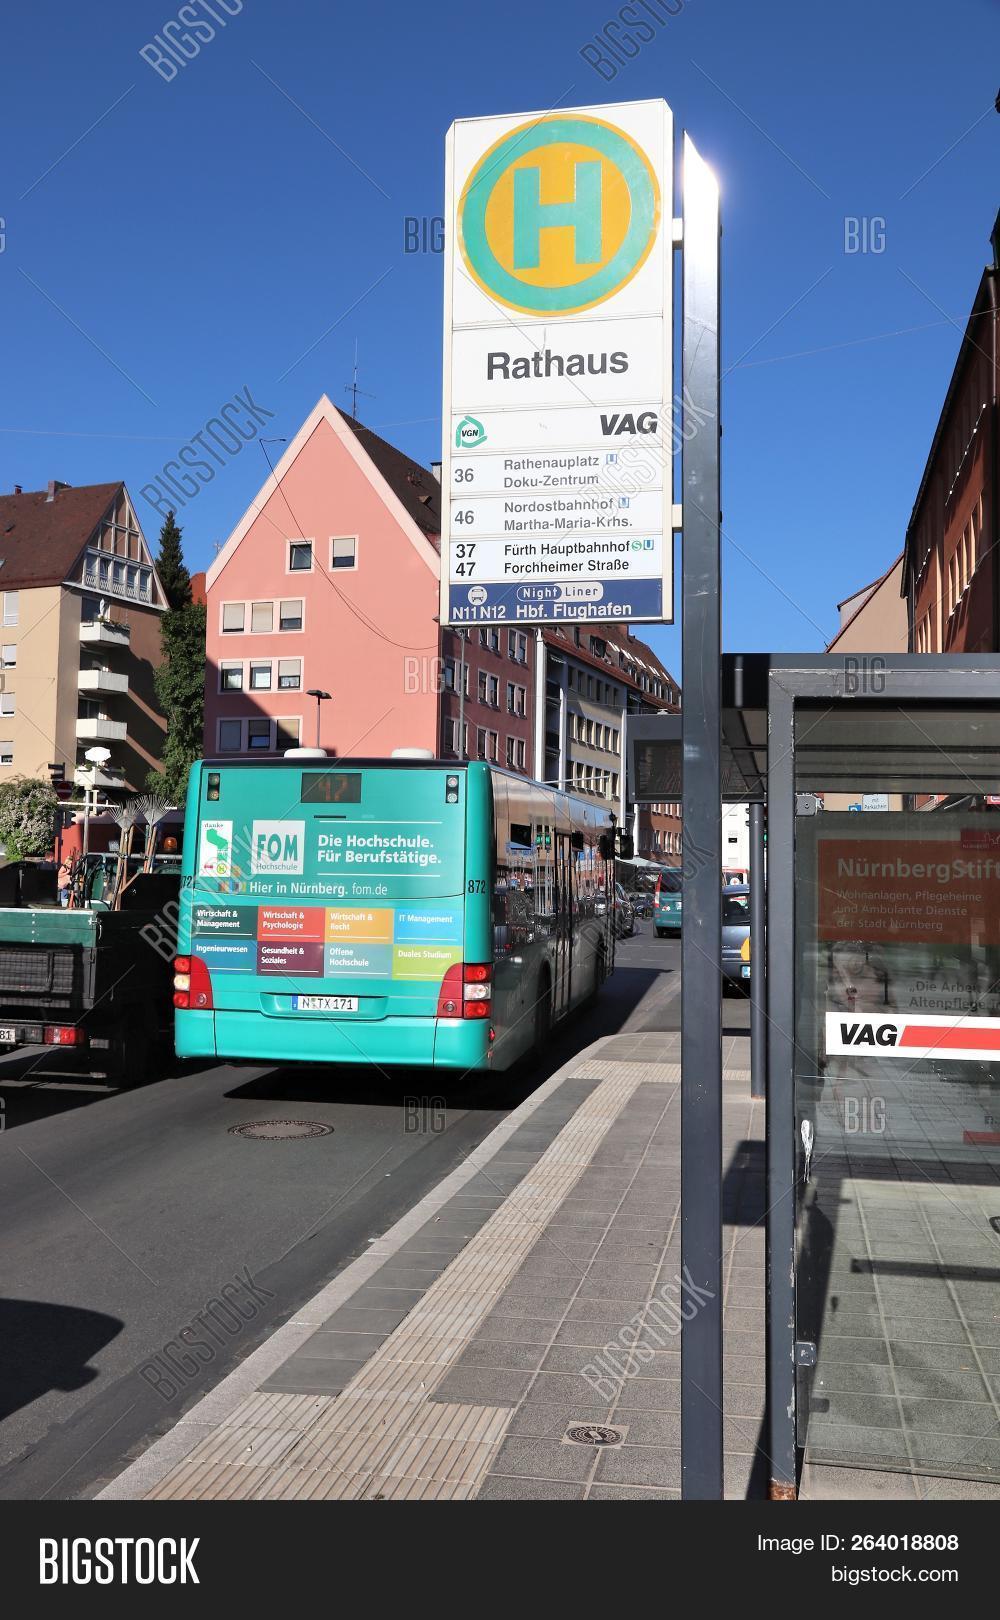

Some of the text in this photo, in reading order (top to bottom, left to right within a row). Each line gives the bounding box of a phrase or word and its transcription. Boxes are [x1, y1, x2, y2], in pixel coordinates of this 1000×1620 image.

[513, 160, 602, 270] H
[487, 349, 629, 381] Rathaus
[600, 412, 659, 436] VAG
[461, 428, 479, 437] VGN
[504, 456, 600, 471] Rathenauplatz
[454, 468, 474, 483] 36
[504, 475, 599, 488] Doku-Zentrum
[504, 498, 614, 513] Nordostbahnhof
[454, 511, 475, 525] 46
[504, 516, 633, 531] Martha-Maria-Krhs.
[455, 544, 476, 559] 37
[504, 543, 537, 556] Fürth
[541, 541, 630, 557] Hauptbahnhof
[455, 562, 476, 577] 47
[504, 558, 630, 574] Forchheimer Straße
[523, 587, 598, 600] Night Liner
[453, 602, 632, 620] N11 N12 Hbf. Flughafen
[257, 833, 298, 862] FOM
[318, 834, 434, 849] Die Hochschule.
[317, 849, 442, 867] Für Berufstätige.
[256, 862, 298, 871] Hochschule
[182, 875, 193, 888] 72
[467, 880, 486, 894] 872
[250, 881, 388, 899] Hier in Nürnberg. fom.de
[836, 887, 982, 904] Wohnanlagen, Pflegeheime
[197, 909, 231, 917] Wirtschaft
[263, 911, 305, 920] Wirtschaft &
[330, 912, 373, 921] Wirtschaft &
[836, 903, 968, 916] und Ambulante Dienste
[197, 920, 240, 929] Management
[263, 921, 304, 931] Psychologie
[330, 922, 350, 931] Recht
[399, 914, 453, 925] IT Management
[836, 917, 943, 931] der Stadt Nürnberg
[196, 944, 248, 954] Ingenieurwesen
[261, 946, 305, 955] Gesundheit &
[329, 947, 354, 956] Offene
[398, 949, 452, 959] Duales Studium
[261, 956, 287, 965] Soziales
[329, 957, 370, 967] Hochschule
[909, 997, 986, 1013] Altenpflege
[840, 1023, 898, 1047] VAG
